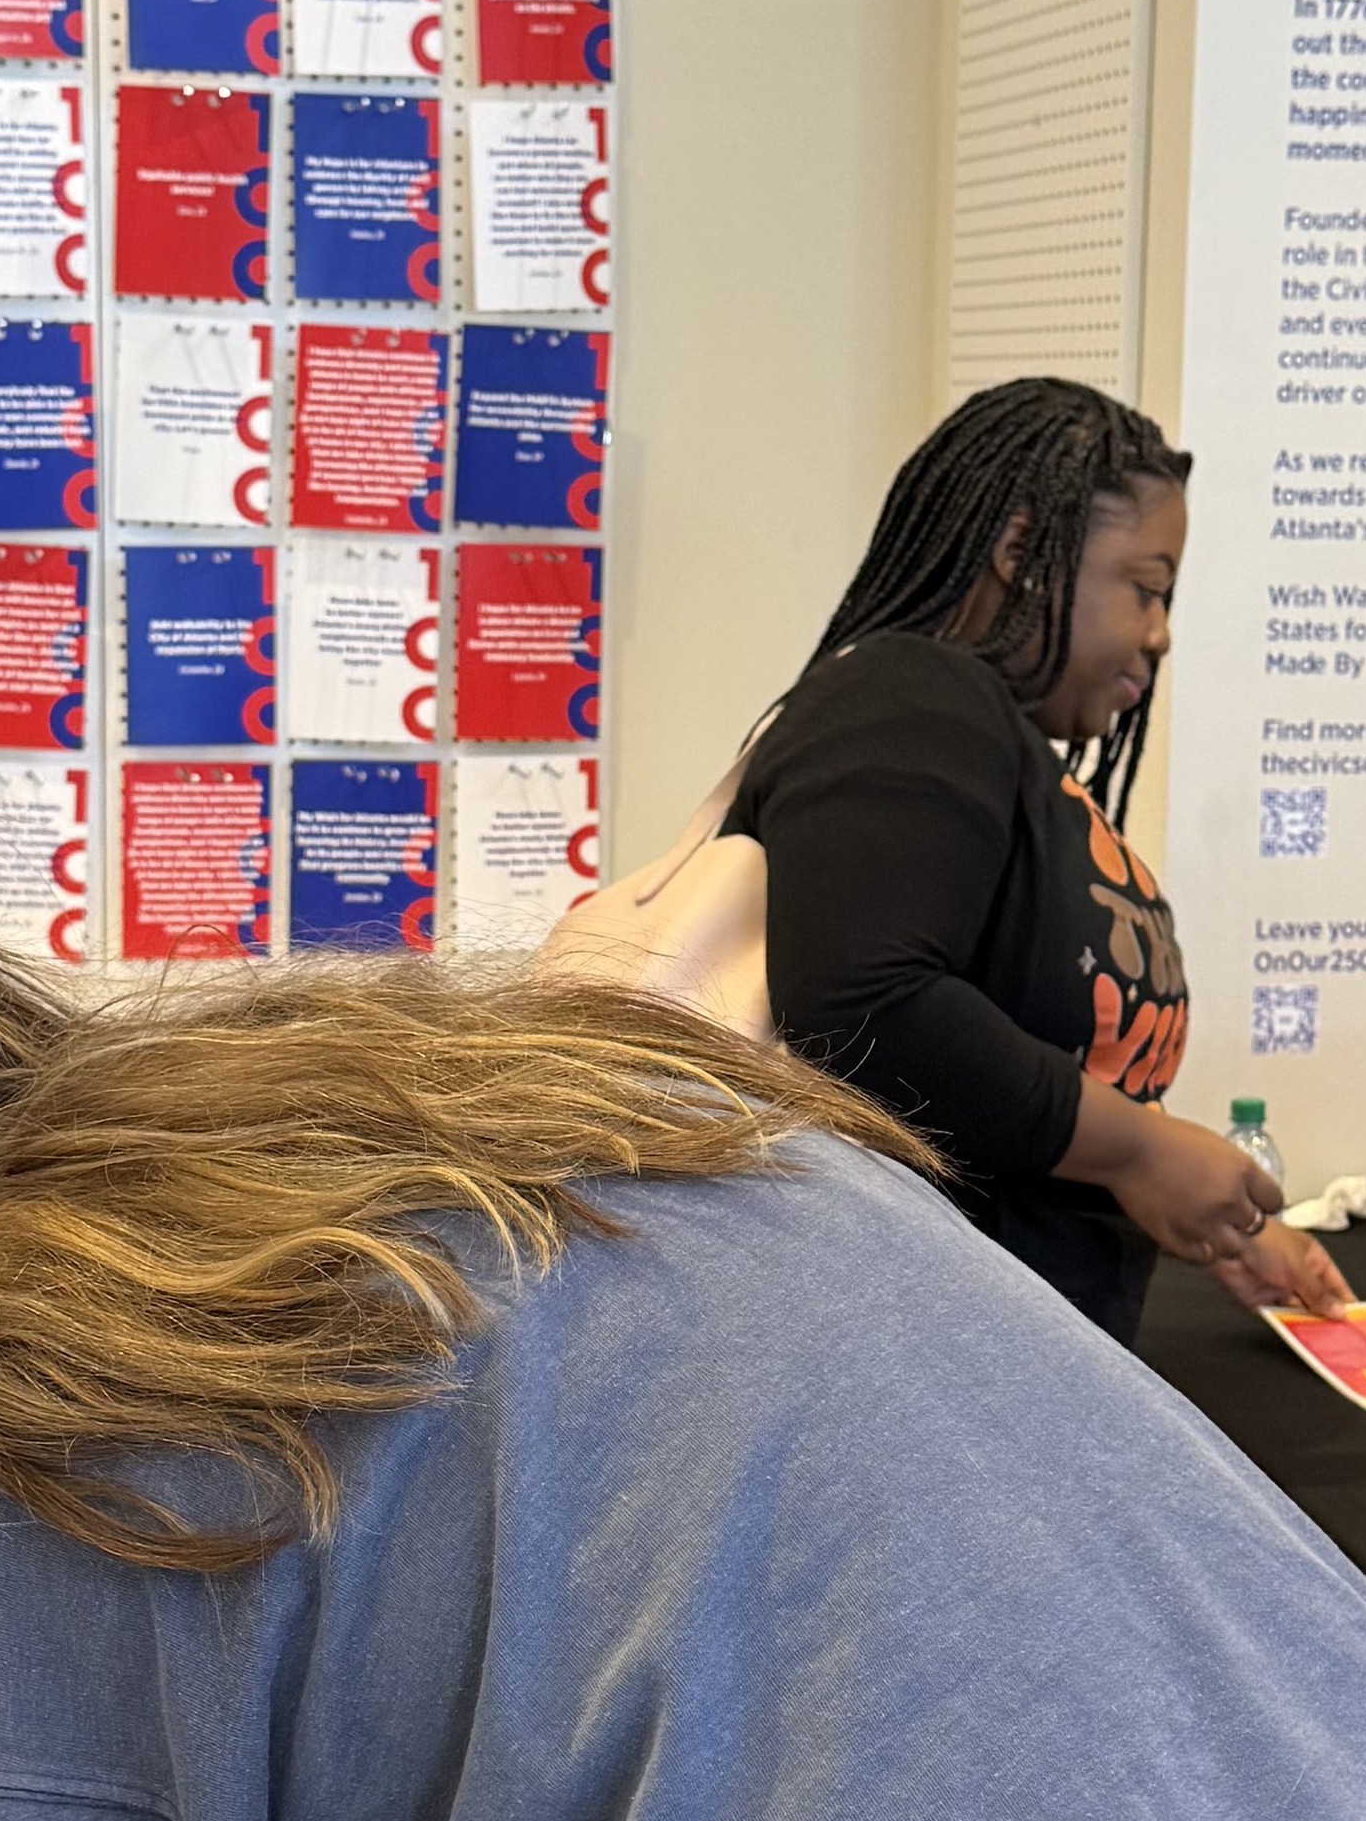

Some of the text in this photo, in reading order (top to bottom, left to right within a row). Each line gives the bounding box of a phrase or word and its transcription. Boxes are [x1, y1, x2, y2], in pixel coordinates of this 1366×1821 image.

[1291, 34, 1333, 55] out
[1290, 67, 1331, 90] the
[1282, 243, 1330, 266] role
[1334, 243, 1358, 266] in
[1281, 279, 1322, 300] the
[1278, 311, 1325, 335] and
[1273, 450, 1305, 472] As
[1309, 455, 1345, 472] we
[1272, 484, 1366, 506] towards
[1268, 586, 1327, 607] Wish
[1266, 619, 1340, 641] States
[1262, 719, 1315, 741] Find
[1255, 920, 1324, 941] Leave
